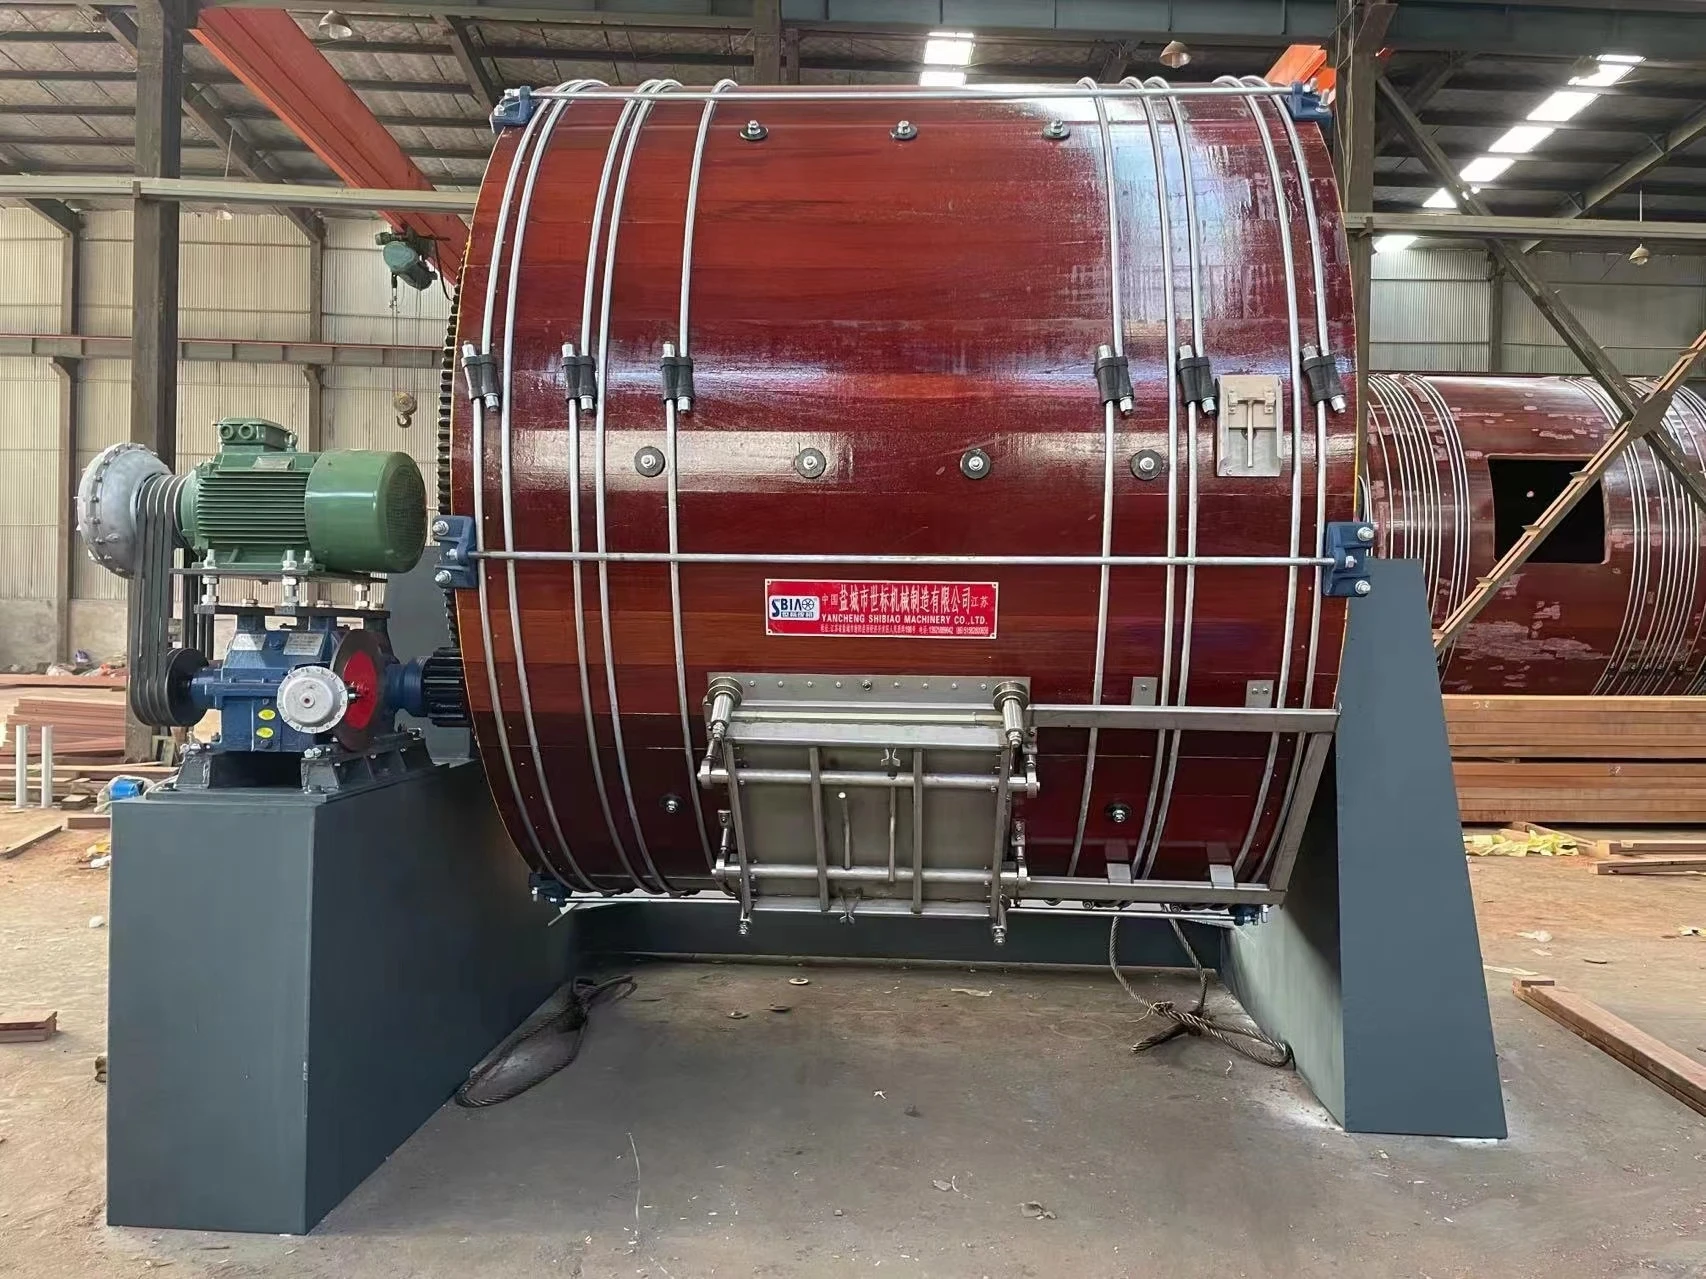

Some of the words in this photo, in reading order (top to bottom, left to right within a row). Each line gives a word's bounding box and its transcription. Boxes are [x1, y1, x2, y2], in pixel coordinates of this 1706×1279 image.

[822, 594, 838, 606] 中国
[838, 583, 971, 615] 盐城市世标机械制造有限公司
[971, 595, 989, 607] 江苏
[821, 613, 866, 623] YANCHENG
[868, 614, 901, 624] SHIBIAO
[904, 614, 951, 625] MACHINERY
[954, 615, 988, 626] CO.,LTD.
